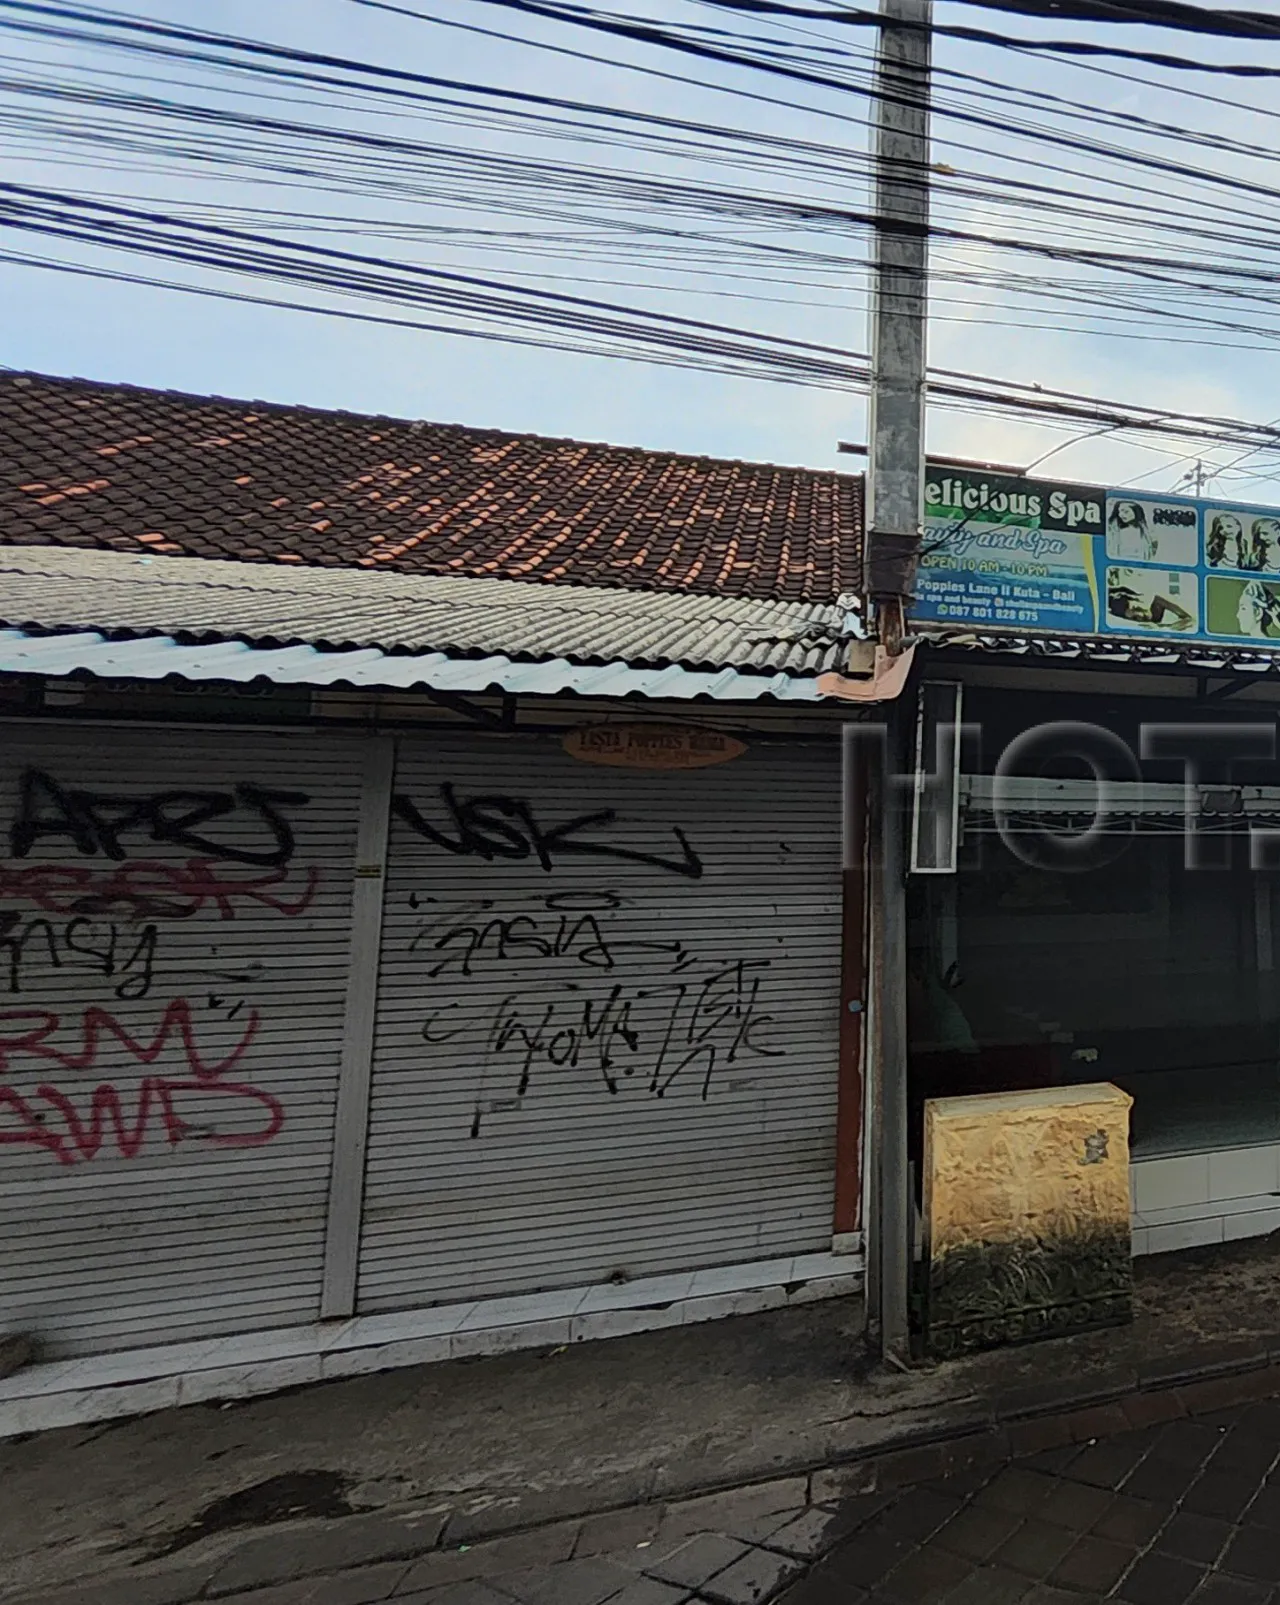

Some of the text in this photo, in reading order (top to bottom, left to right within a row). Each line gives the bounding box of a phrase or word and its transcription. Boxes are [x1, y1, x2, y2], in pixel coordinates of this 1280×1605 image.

[924, 478, 1101, 527] elicious Spa
[976, 529, 1022, 550] and
[1022, 528, 1067, 559] Spa
[921, 555, 956, 569] OPEN
[962, 558, 976, 571] 10
[978, 560, 1000, 572] AM
[1011, 563, 1025, 575] 10
[1027, 564, 1048, 577] PM
[917, 578, 965, 593] Poppies
[969, 582, 998, 596] Lane
[1013, 586, 1040, 598] Kuta
[1052, 589, 1075, 601] Bali
[950, 605, 969, 616] 087
